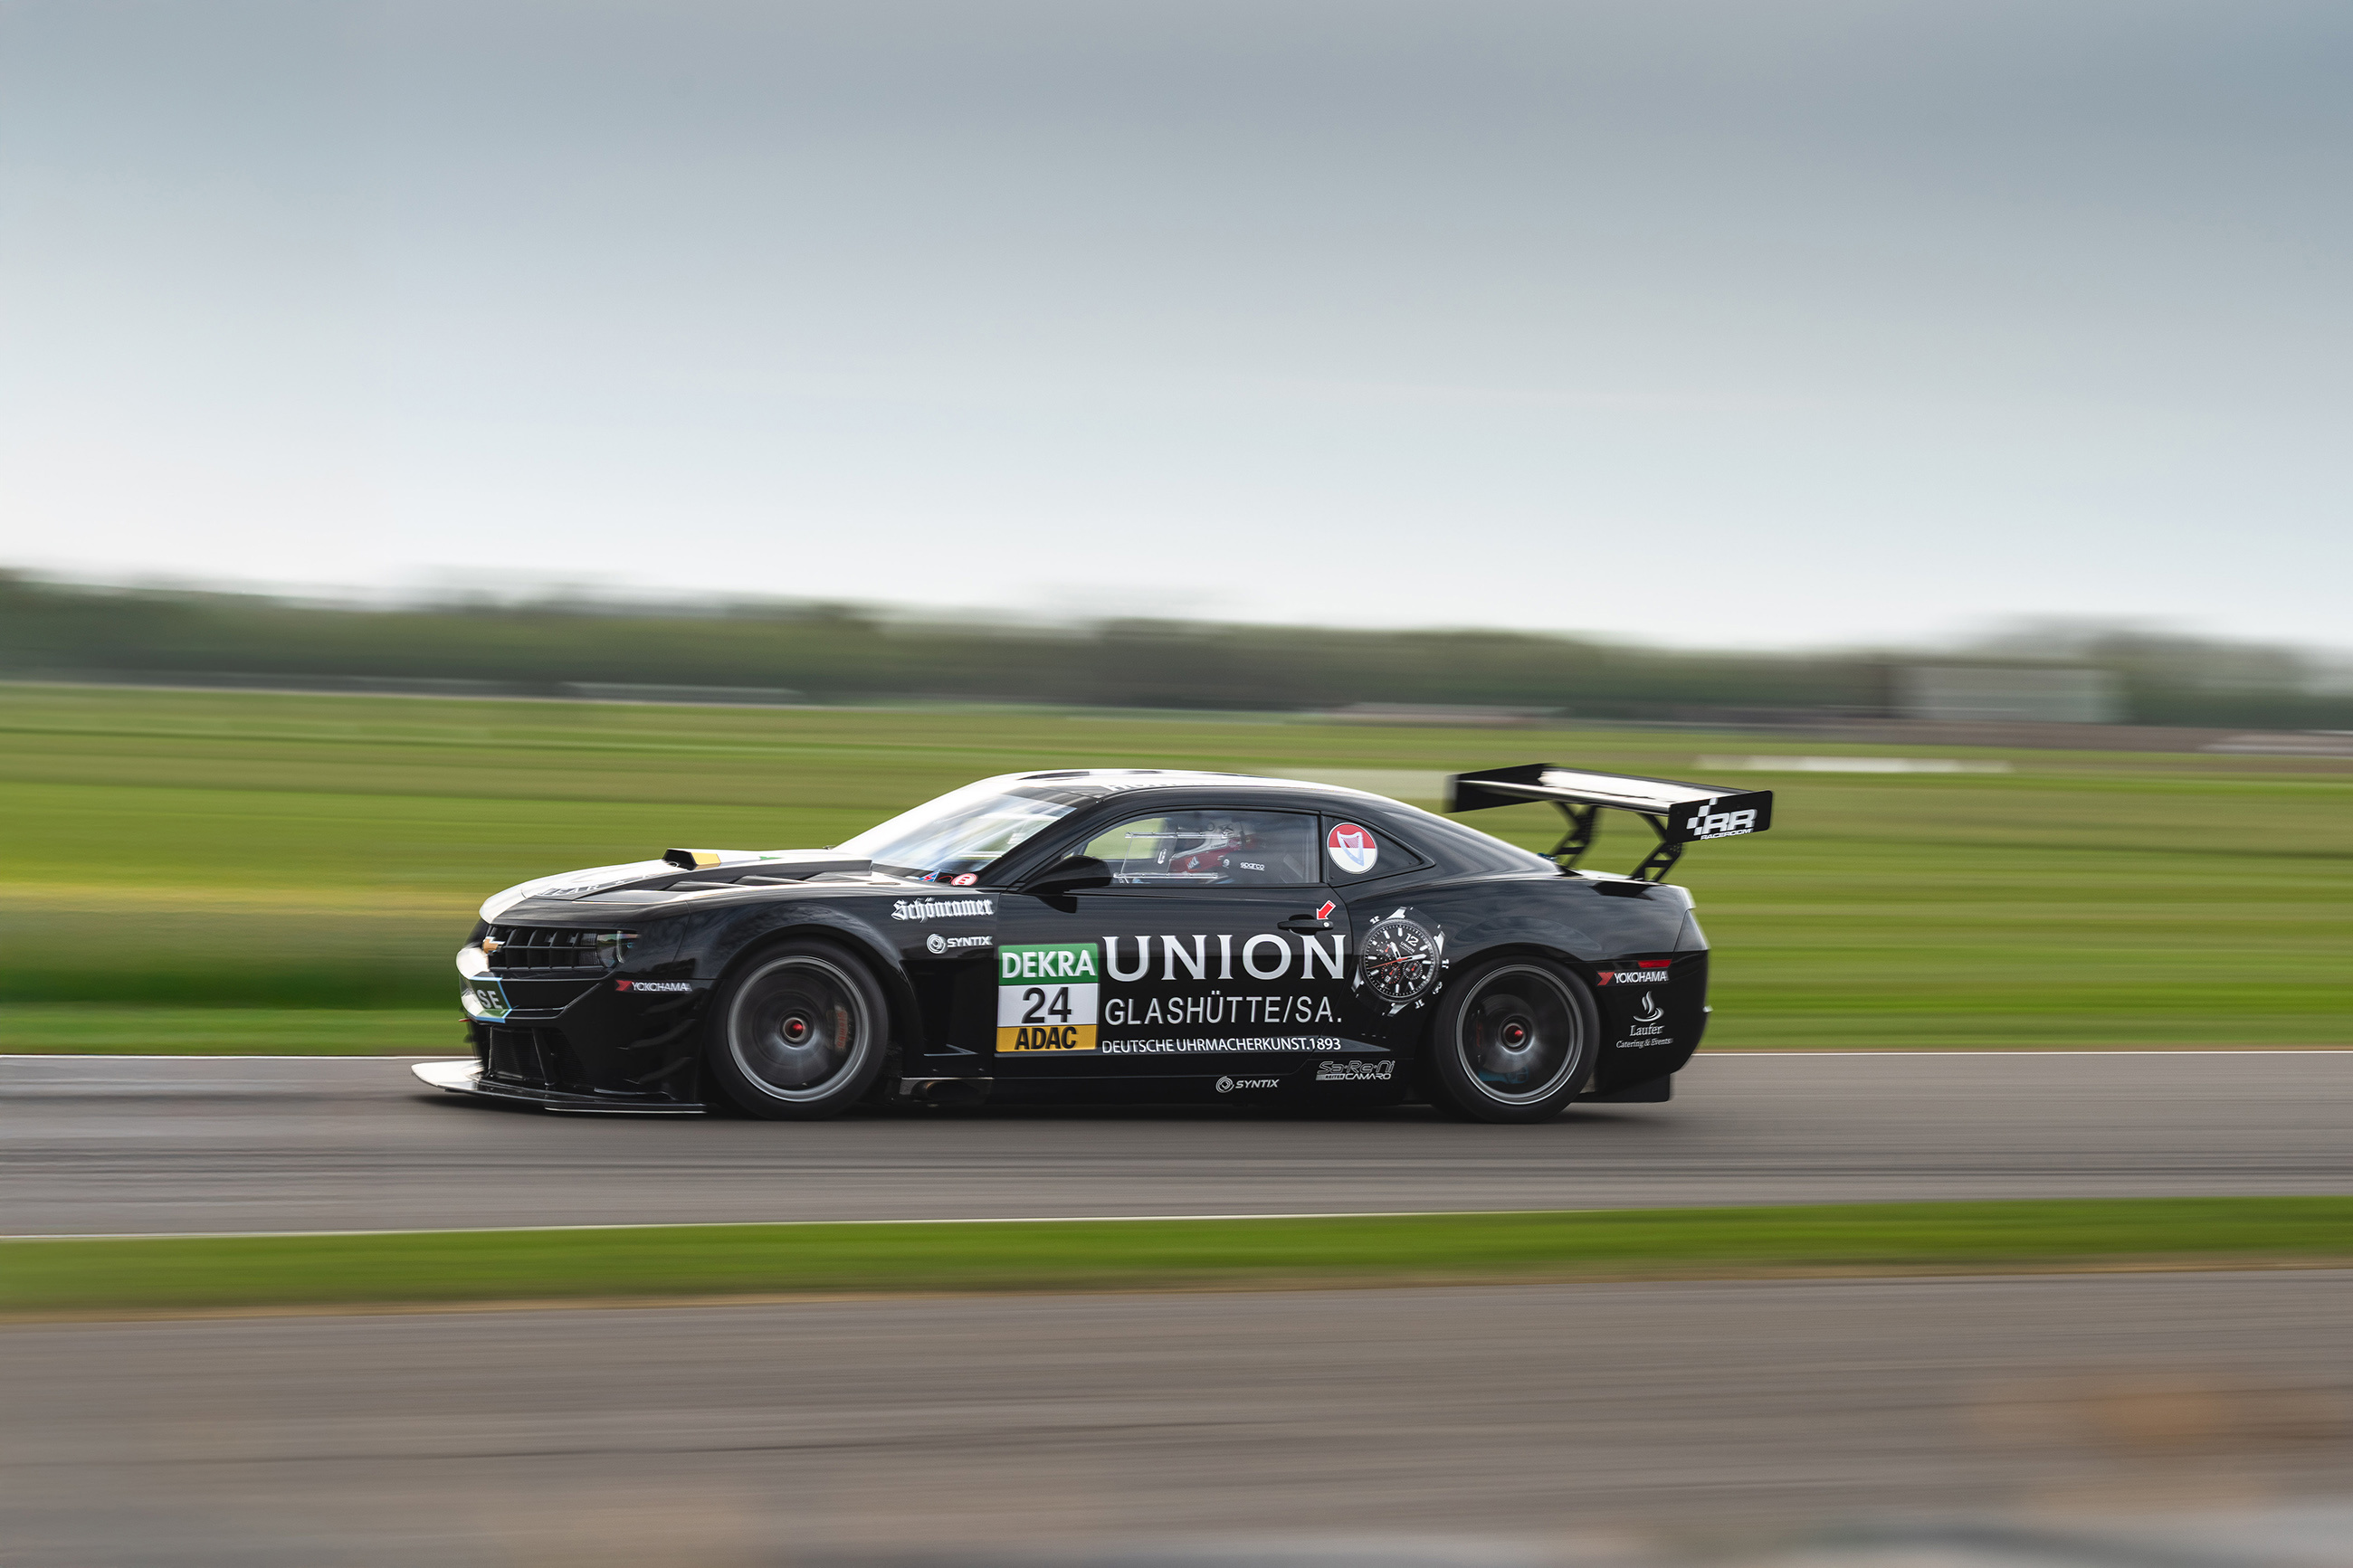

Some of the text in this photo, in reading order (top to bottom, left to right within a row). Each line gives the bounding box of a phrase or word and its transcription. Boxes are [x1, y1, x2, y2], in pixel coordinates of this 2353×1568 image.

[1700, 828, 1753, 841] RACEROOM
[1240, 861, 1265, 871] sparco
[947, 936, 994, 947] SYNTIX
[1405, 933, 1419, 947] 12
[1400, 941, 1415, 954] UNION
[1001, 949, 1097, 979] DEKRA
[1102, 934, 1347, 983] UNION
[1614, 970, 1670, 984] YOKOHAMA
[632, 982, 692, 992] YOKOHAMA
[1021, 986, 1072, 1023] 24
[1104, 990, 1342, 1026] GLASHÜTTE/SA.
[1629, 1022, 1665, 1037] Laufer
[1014, 1026, 1077, 1050] ADAC
[1615, 1039, 1643, 1050] Catering
[1651, 1037, 1673, 1046] Events
[1101, 1040, 1175, 1054] DEUTSCHE
[1235, 1079, 1280, 1088] SYNTIX
